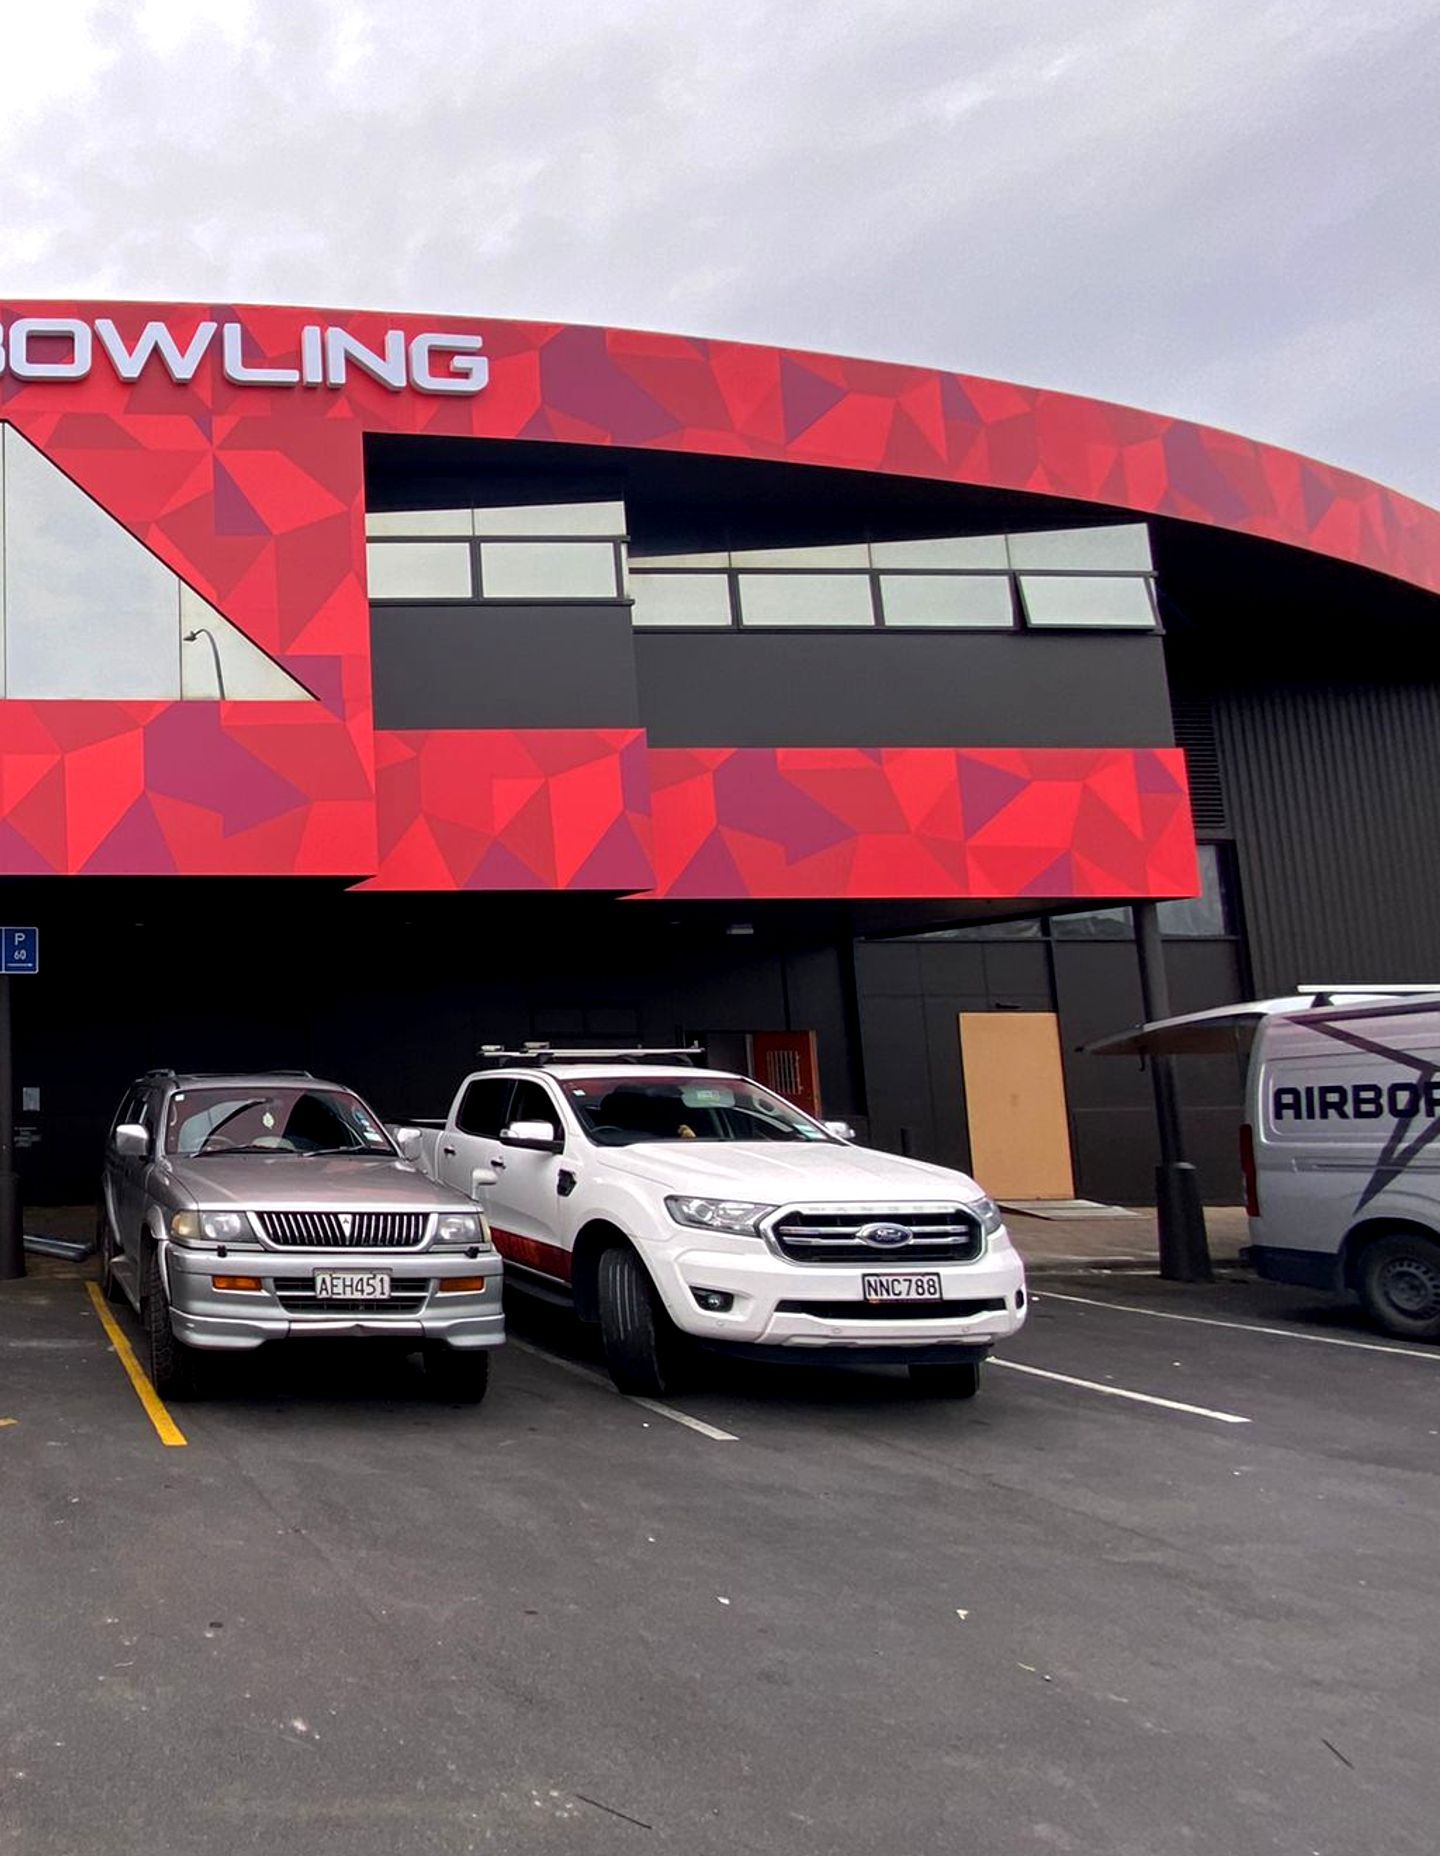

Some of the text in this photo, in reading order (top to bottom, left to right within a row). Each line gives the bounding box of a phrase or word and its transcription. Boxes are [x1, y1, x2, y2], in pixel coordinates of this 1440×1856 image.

[14, 933, 25, 945] P
[14, 949, 26, 960] 60
[318, 1277, 386, 1297] AEH451
[866, 1277, 938, 1298] NNC788
